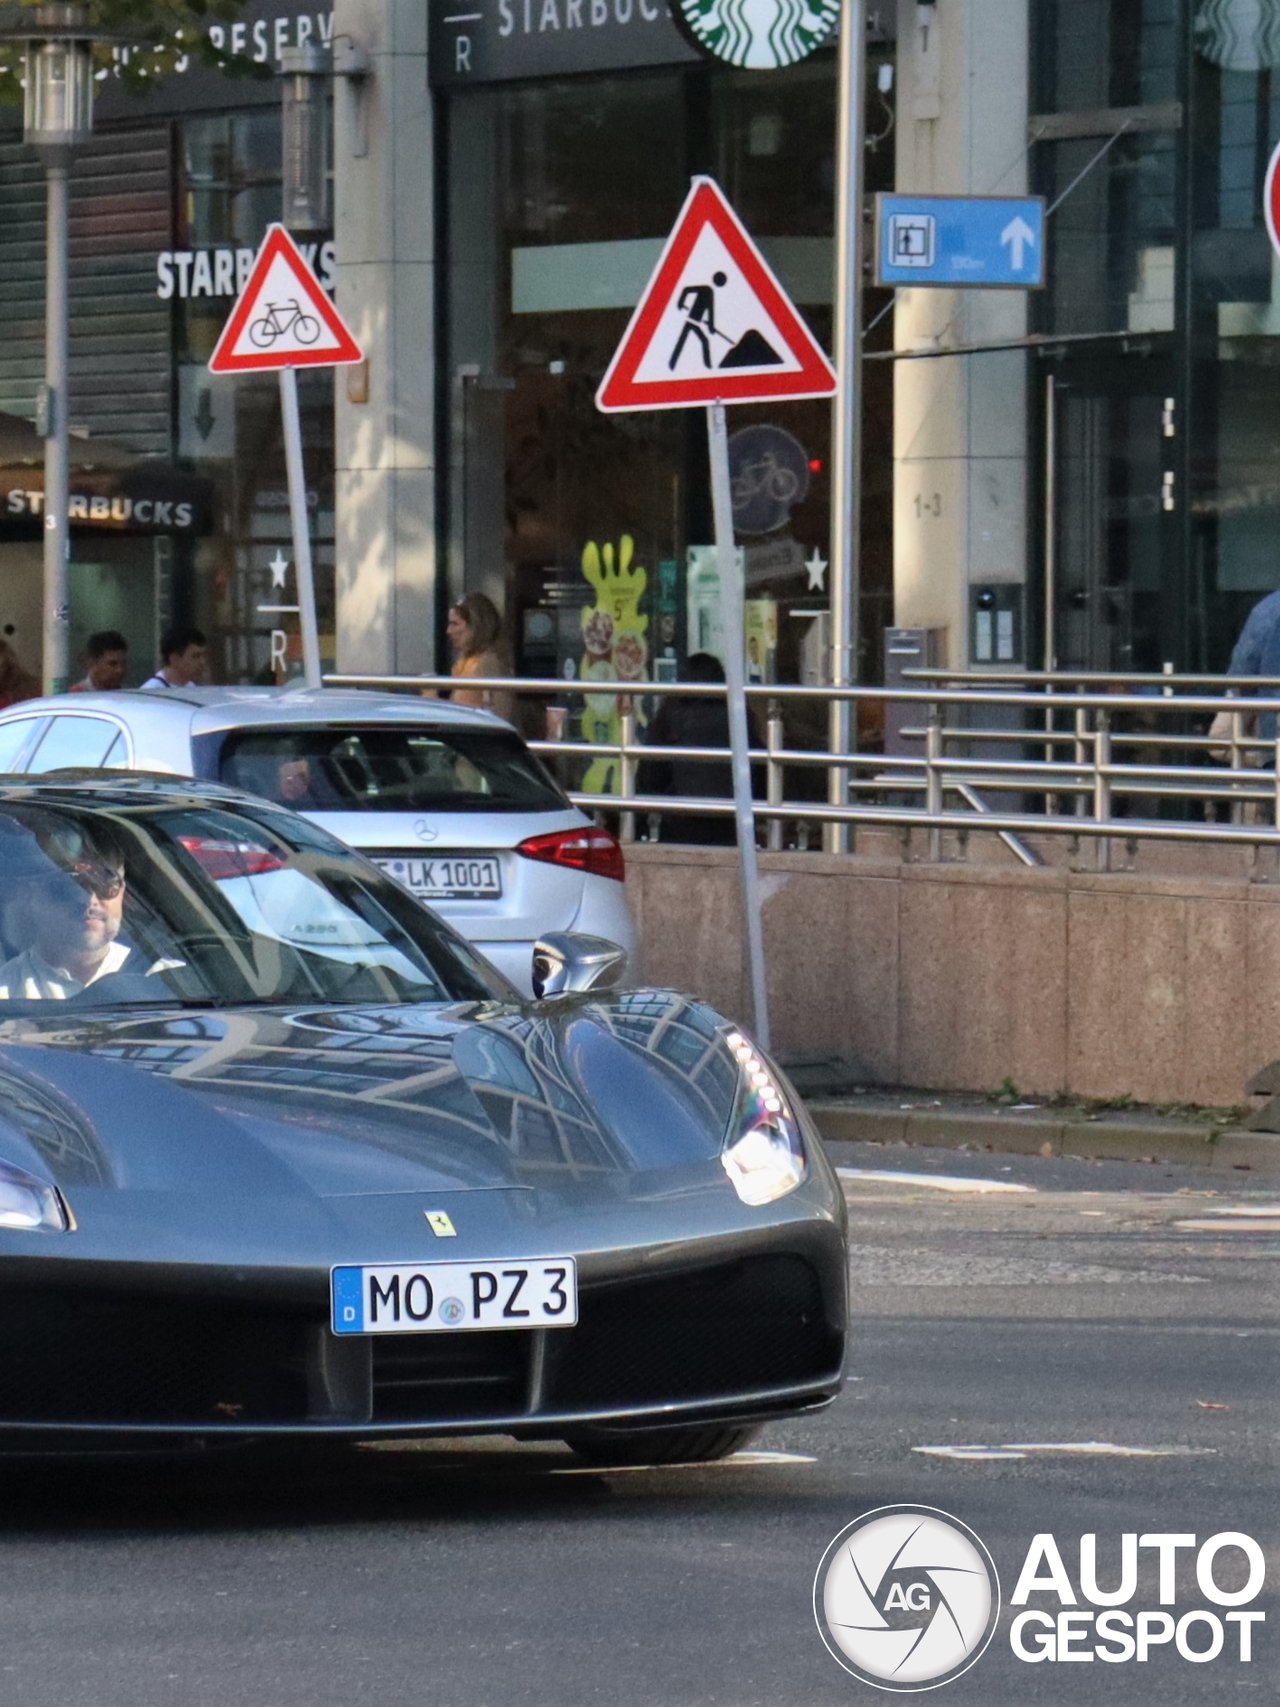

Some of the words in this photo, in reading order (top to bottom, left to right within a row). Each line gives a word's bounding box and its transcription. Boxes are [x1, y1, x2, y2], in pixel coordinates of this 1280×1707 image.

[498, 0, 672, 36] STARBUC
[209, 12, 335, 62] RESERV
[455, 35, 471, 72] R
[7, 489, 193, 528] STRBUCKS
[45, 513, 57, 530] 3
[271, 629, 287, 672] R
[408, 862, 436, 887] LK
[440, 862, 496, 887] 1001
[370, 1274, 434, 1322] MO
[470, 1269, 530, 1319] PZ
[542, 1267, 568, 1315] 3
[343, 1306, 356, 1322] D
